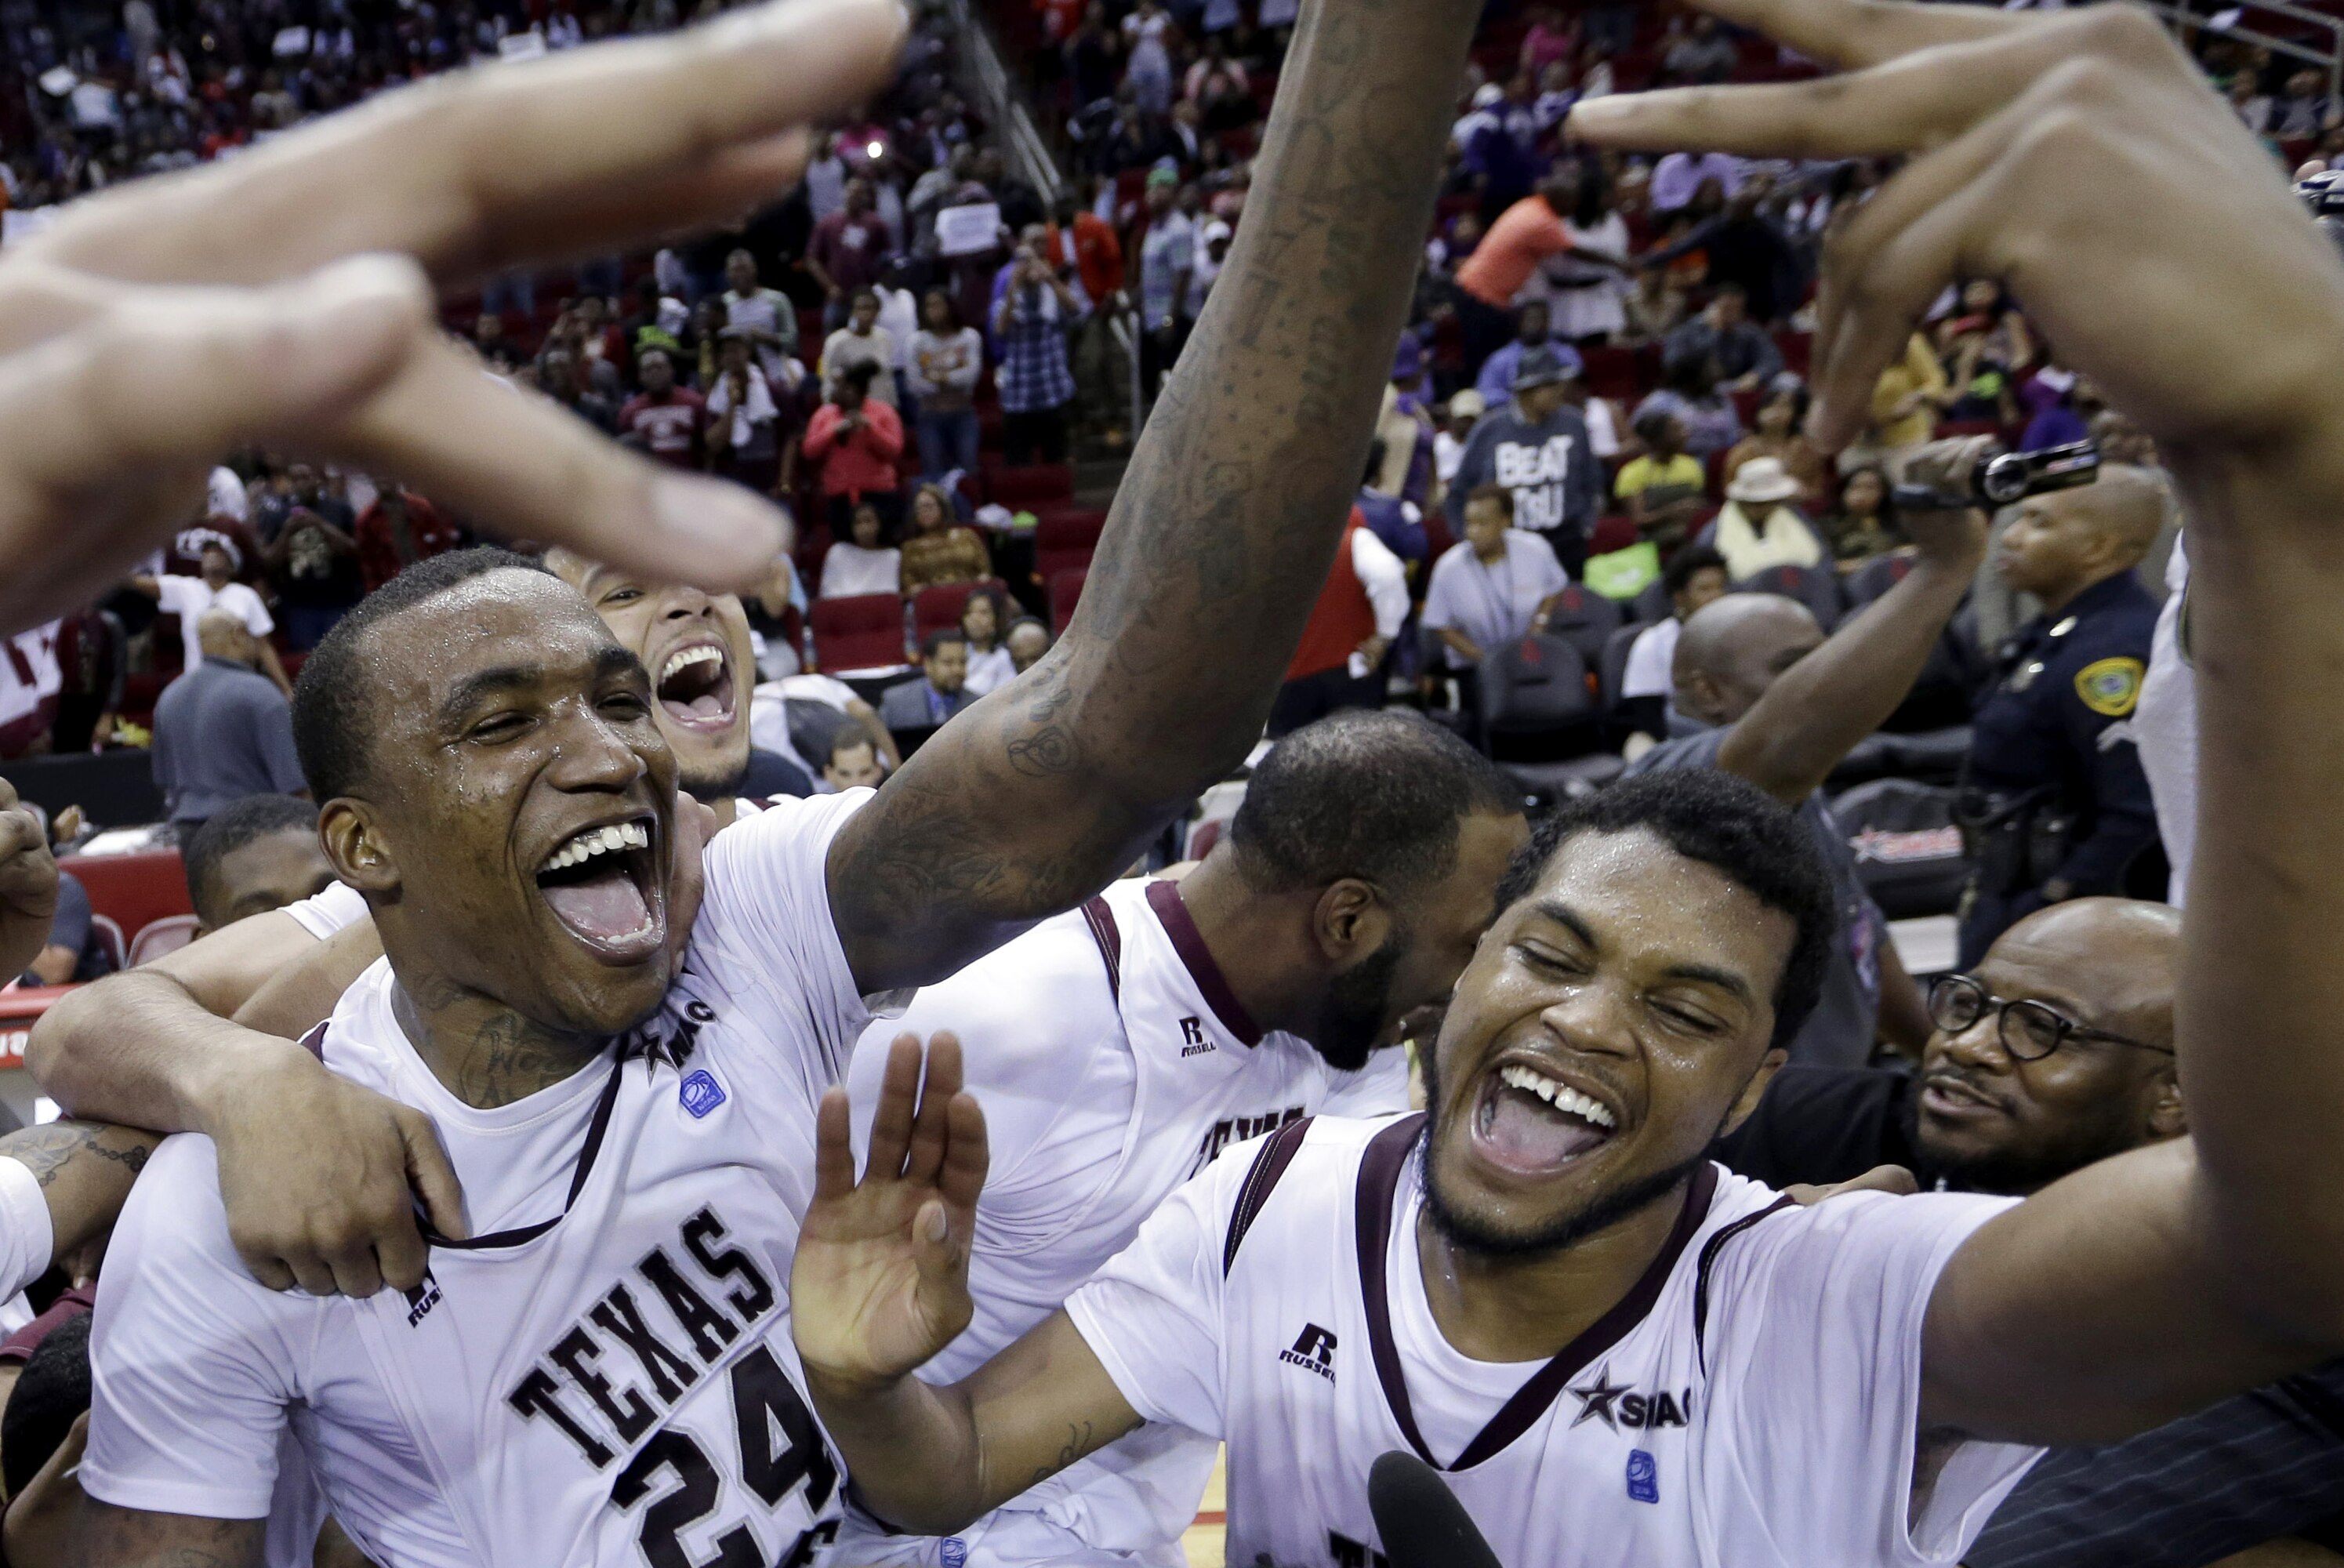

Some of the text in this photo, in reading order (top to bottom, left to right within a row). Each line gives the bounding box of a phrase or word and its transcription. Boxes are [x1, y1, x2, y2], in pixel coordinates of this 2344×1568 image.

[1494, 434, 1573, 487] BEAT
[1511, 482, 1566, 529] TSU
[1179, 1016, 1203, 1045] R
[408, 1286, 443, 1329] RUS
[502, 1201, 782, 1474] TEXAS
[1291, 1322, 1337, 1367] R
[1279, 1349, 1336, 1388] RUSSEL
[608, 1334, 847, 1568] 24
